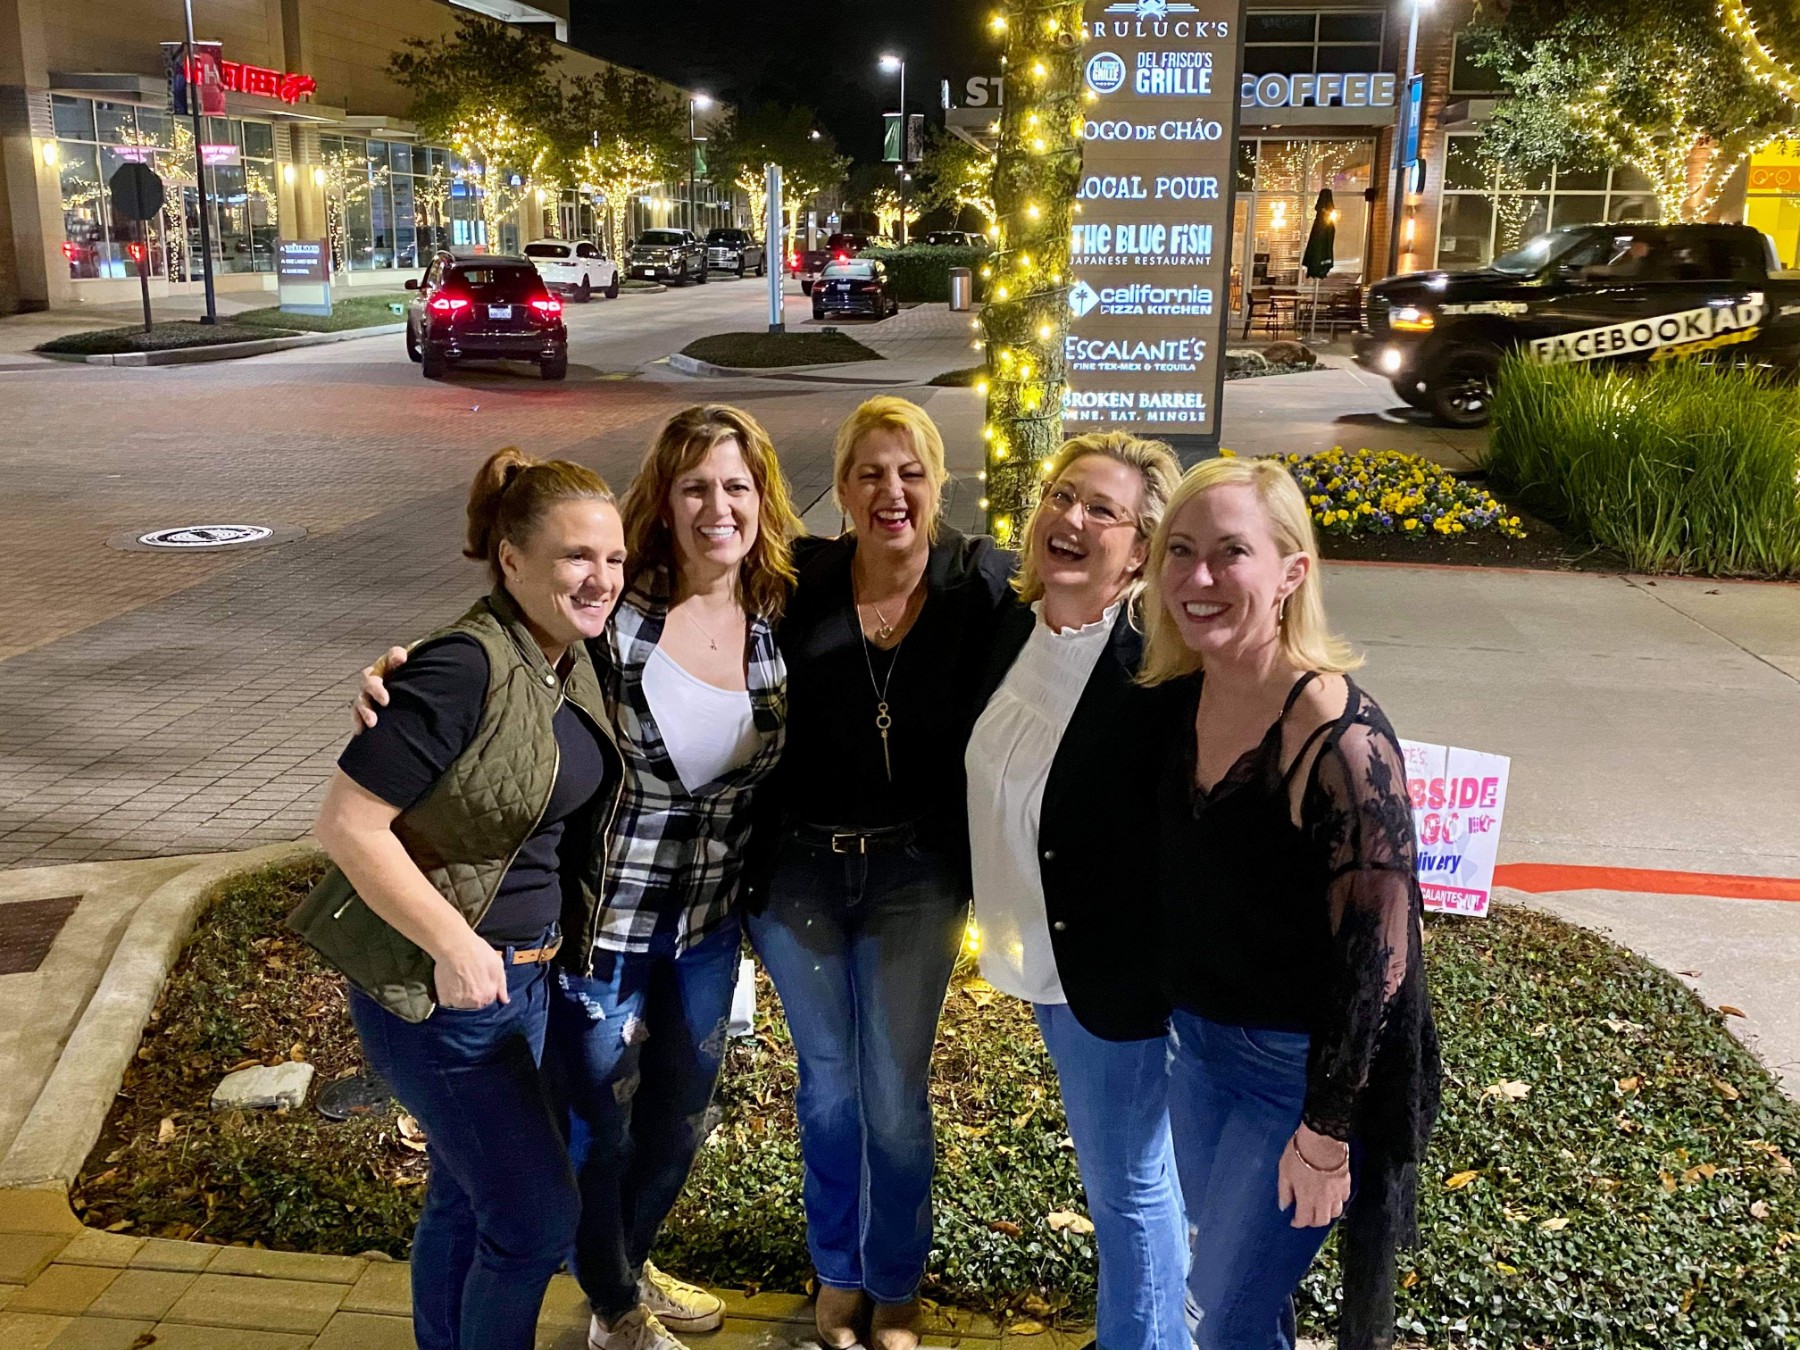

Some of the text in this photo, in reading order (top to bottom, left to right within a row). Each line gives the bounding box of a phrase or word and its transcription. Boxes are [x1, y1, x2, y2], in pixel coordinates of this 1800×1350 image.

[1137, 51, 1159, 68] DEL
[1161, 51, 1213, 68] FRISCO'S
[1136, 68, 1213, 94] GRILLE
[1241, 73, 1396, 107] COFFEE
[1084, 118, 1223, 140] OGO DE CHÃO
[1155, 177, 1219, 199] POUR
[1069, 256, 1211, 266] JAPANESE RESTAURANT
[1100, 284, 1213, 303] california
[1101, 305, 1213, 315] PIZZA KITCHEN
[1536, 311, 1706, 361] FACEBOOK
[1065, 336, 1207, 361] ESCALANTE'S
[1073, 363, 1096, 371] FINE
[1098, 363, 1141, 371] TEX-MEX
[1154, 363, 1197, 372] TEQUILA
[1061, 391, 1207, 408] BROKEN BARREL
[1146, 411, 1206, 422] MINGLE
[1407, 777, 1499, 810] BSIDE
[1417, 851, 1462, 875] livery
